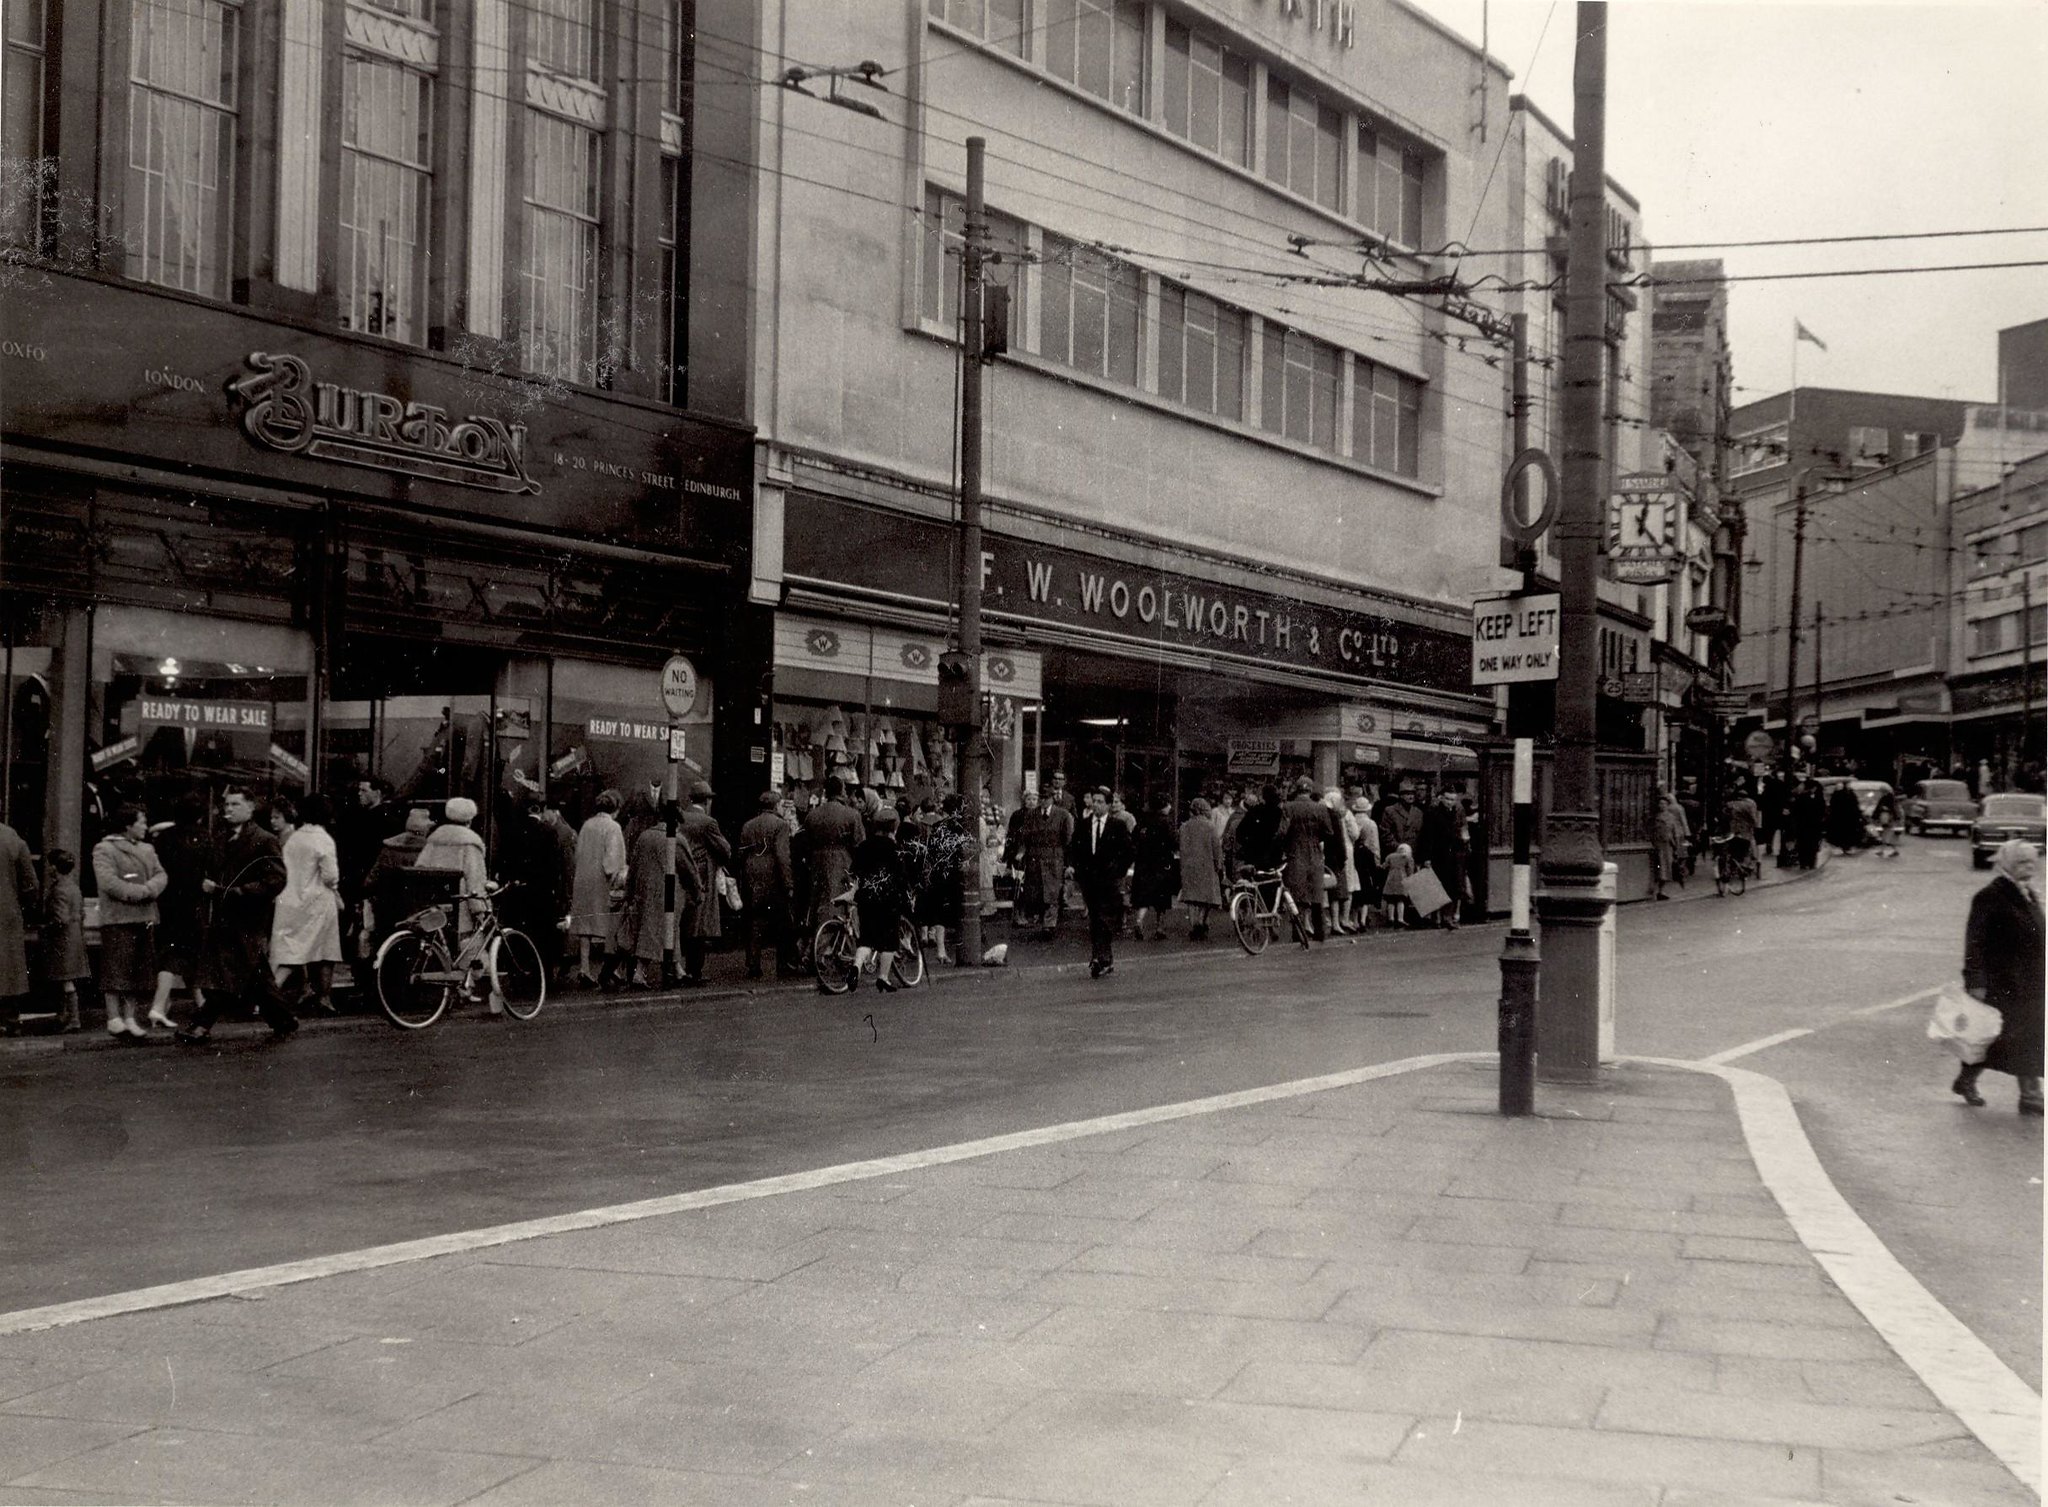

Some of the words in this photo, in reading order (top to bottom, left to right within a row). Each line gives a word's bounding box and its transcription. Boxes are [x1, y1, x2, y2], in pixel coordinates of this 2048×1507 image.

[145, 369, 206, 393] LONDON
[236, 352, 540, 495] BURTON
[594, 460, 634, 479] PRINCES
[641, 471, 675, 489] STREET
[685, 479, 742, 501] EDINBURGH
[1027, 560, 1062, 606] W.
[1080, 572, 1291, 650] WOOLWORTH
[1309, 626, 1321, 655] &
[1476, 614, 1512, 641] KEEP
[1519, 609, 1556, 637] LEFT
[1480, 656, 1498, 672] ONE
[1502, 653, 1522, 670] WAY
[1526, 652, 1551, 669] ONLY
[672, 669, 688, 683] NO
[664, 687, 694, 698] WAITING
[141, 701, 181, 720] READY
[184, 704, 200, 722] TO
[203, 705, 237, 724] WEAR
[241, 708, 267, 726] SALE
[589, 719, 617, 736] READY
[620, 722, 631, 738] TO
[633, 723, 657, 740] WEAR
